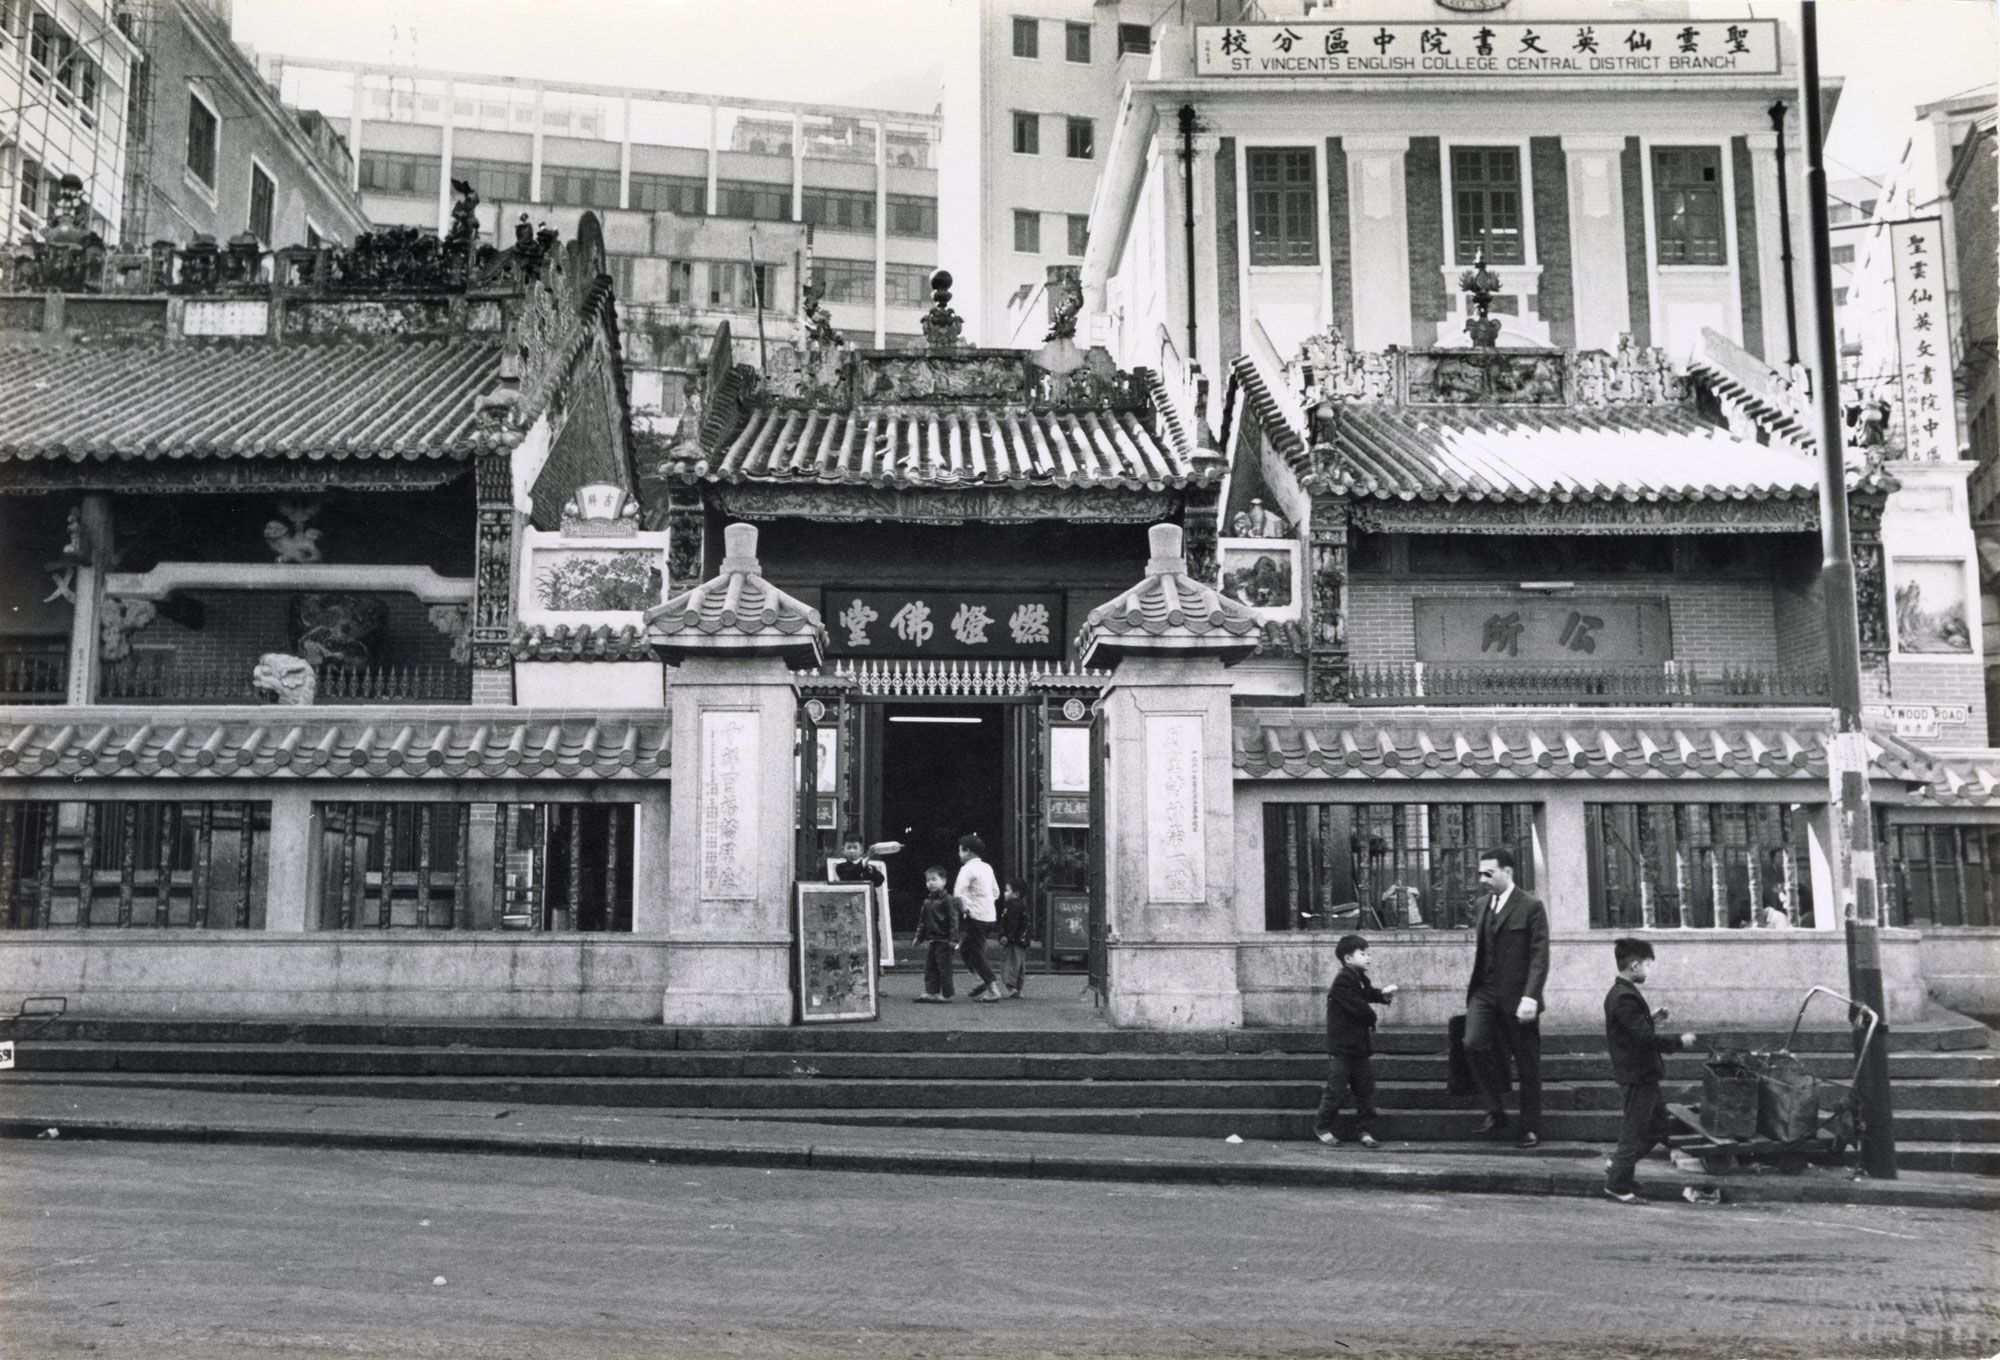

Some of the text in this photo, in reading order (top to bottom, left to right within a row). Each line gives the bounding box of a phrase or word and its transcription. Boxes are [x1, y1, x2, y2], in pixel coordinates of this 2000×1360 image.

[1261, 57, 1339, 70] VINCENTS
[1347, 57, 1415, 70] ENGLISH
[1423, 57, 1498, 70] COLLEGE
[1507, 57, 1582, 70] CENTRAL
[1590, 57, 1660, 69] DISTRICT
[1670, 56, 1736, 69] BRANCH
[1481, 610, 1604, 657] 公所
[1934, 709, 1964, 721] ROAD
